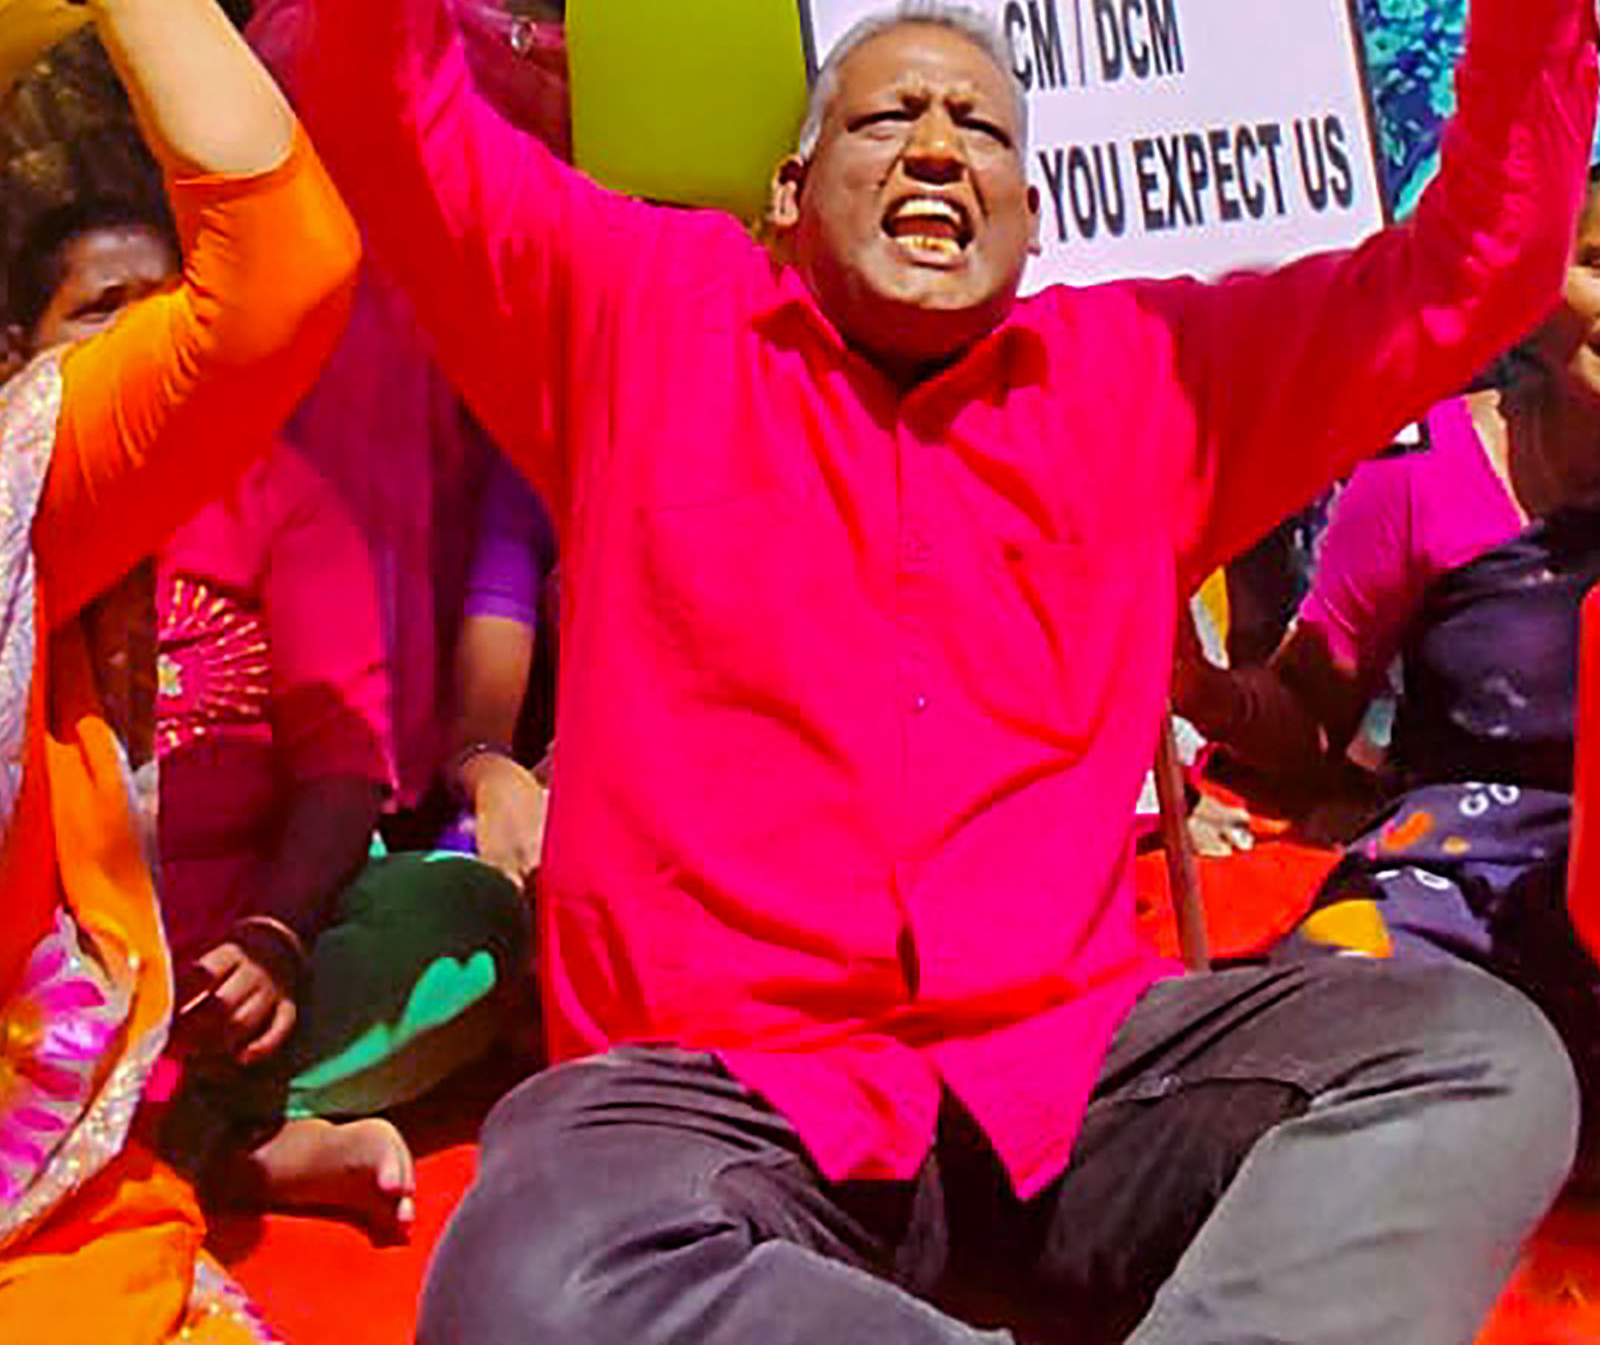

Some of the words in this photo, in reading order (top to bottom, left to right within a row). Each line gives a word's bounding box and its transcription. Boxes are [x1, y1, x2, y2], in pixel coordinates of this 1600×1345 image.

[1038, 143, 1125, 242] YOU
[1133, 124, 1285, 230] EXPECT
[1294, 116, 1352, 211] US
